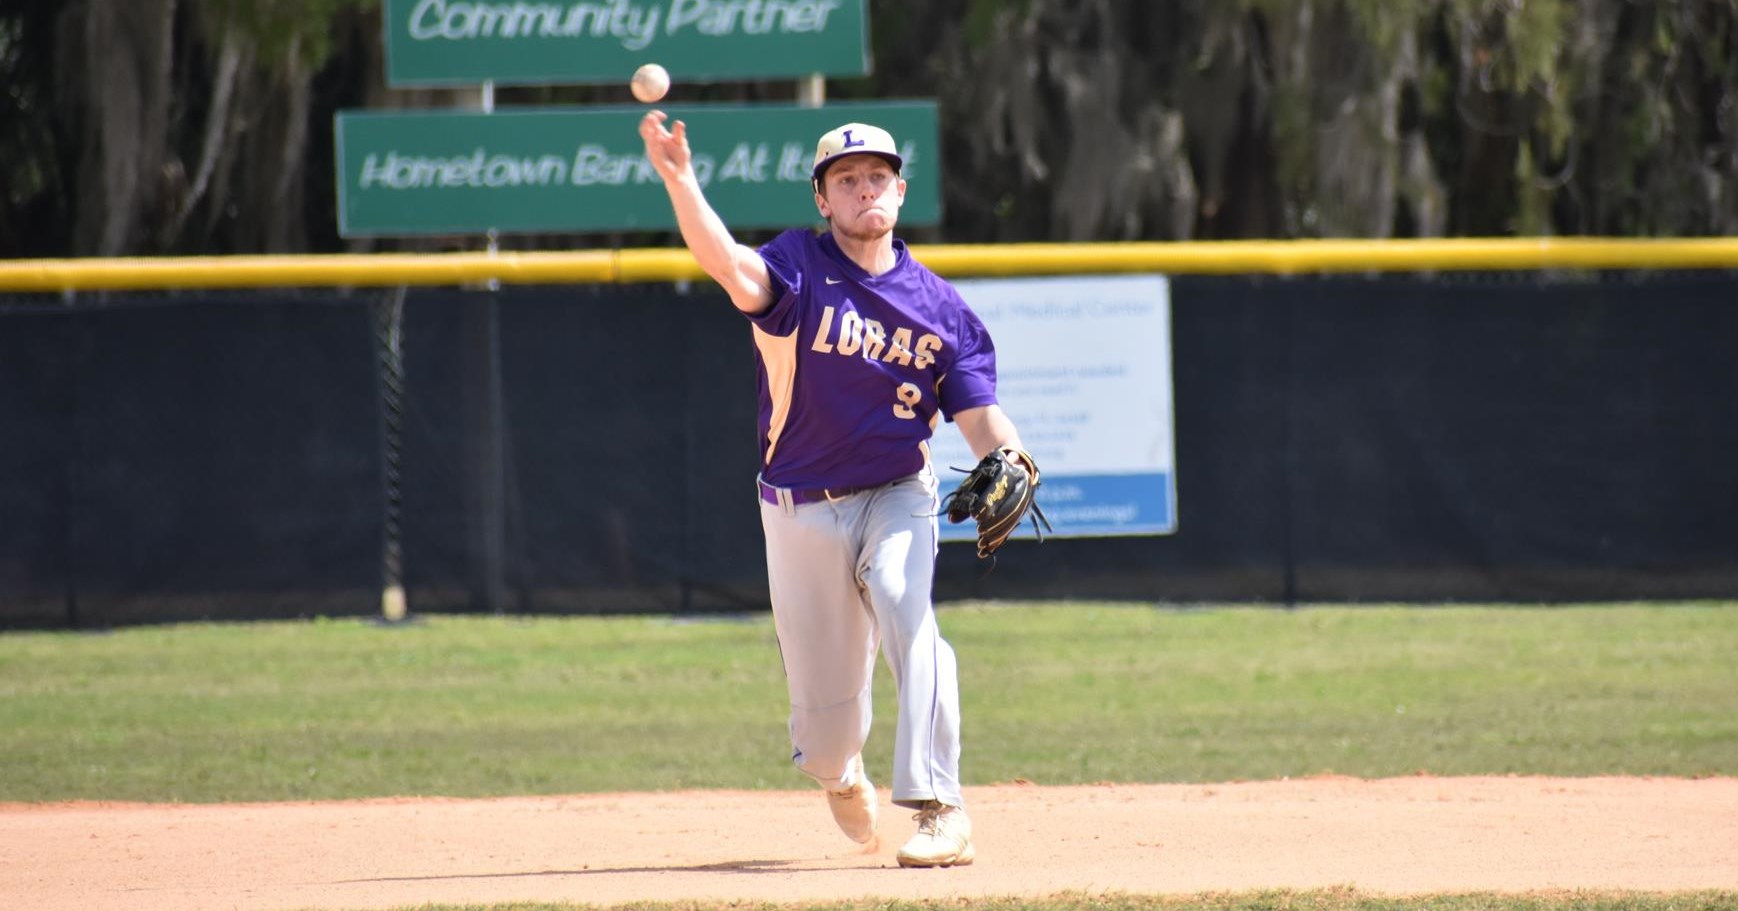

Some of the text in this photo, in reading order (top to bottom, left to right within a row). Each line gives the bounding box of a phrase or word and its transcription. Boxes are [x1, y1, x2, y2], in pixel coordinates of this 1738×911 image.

[409, 0, 838, 51] Community Partner
[843, 130, 865, 148] L
[359, 148, 567, 190] Hometown
[571, 145, 715, 192] Bankg
[718, 142, 771, 182] At
[811, 305, 943, 370] LORAS
[893, 382, 922, 420] 9
